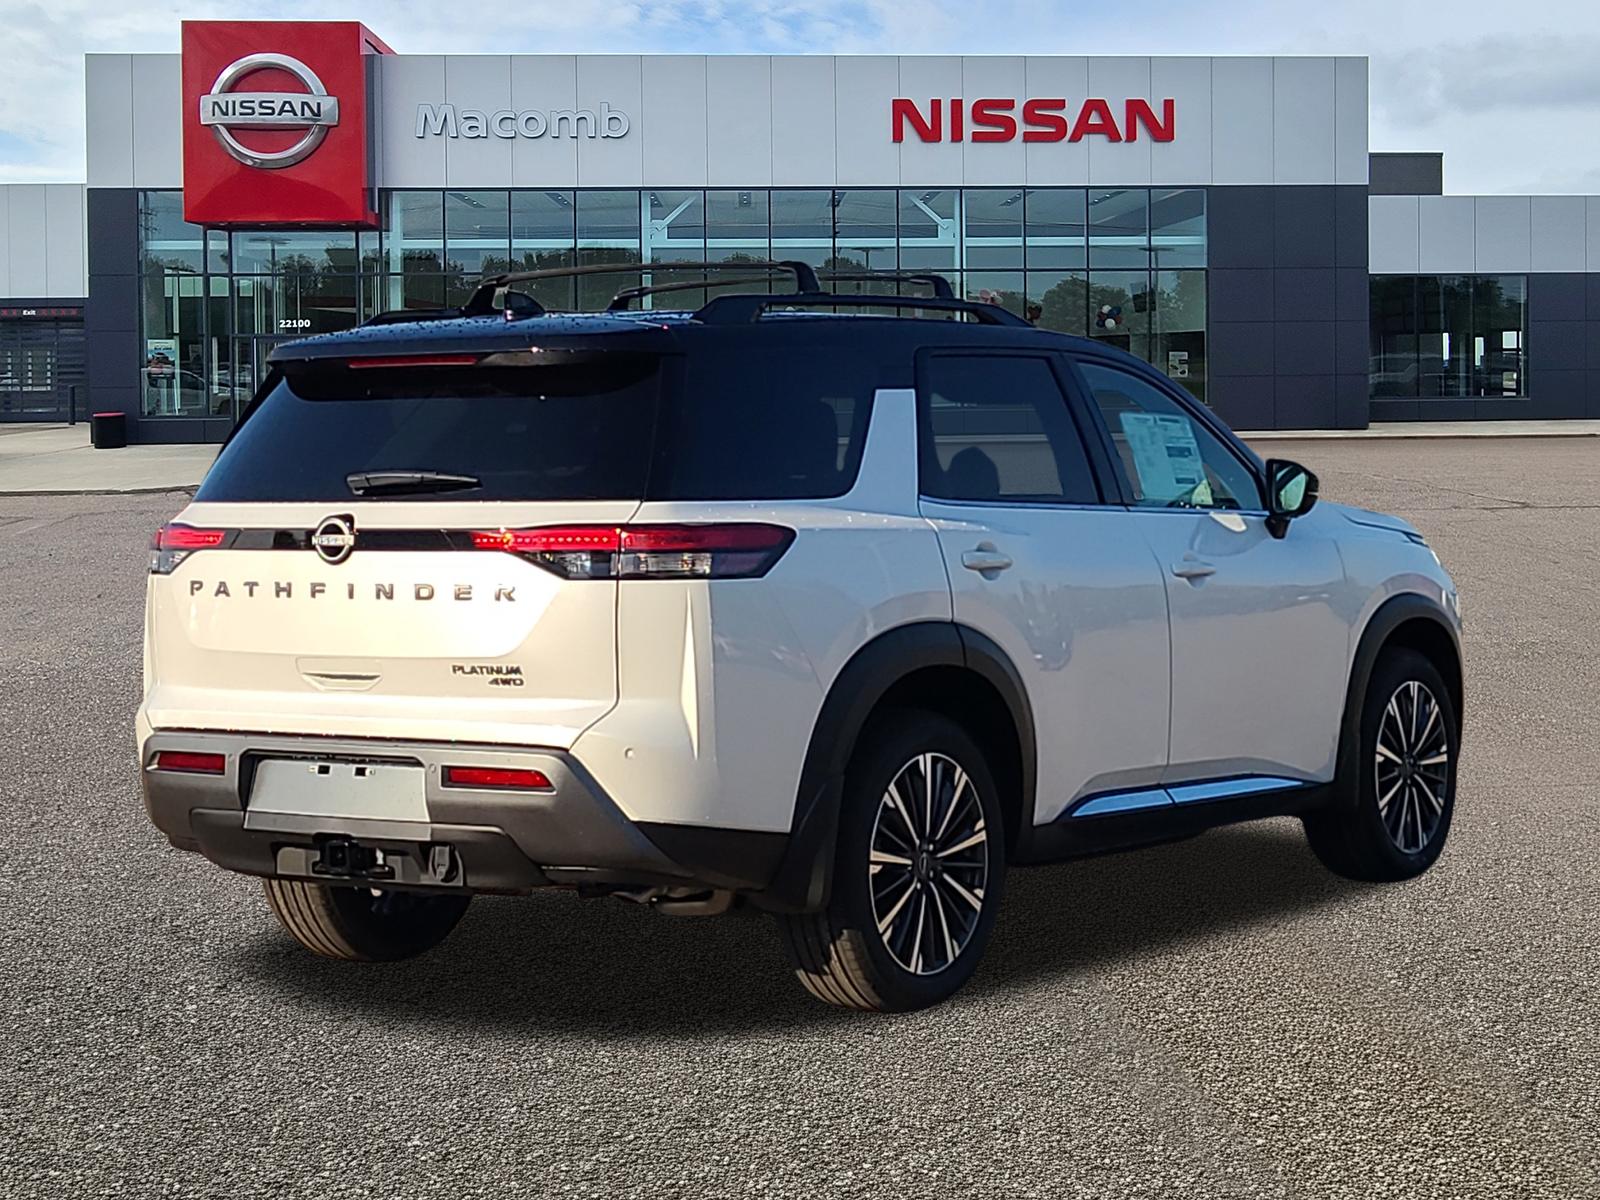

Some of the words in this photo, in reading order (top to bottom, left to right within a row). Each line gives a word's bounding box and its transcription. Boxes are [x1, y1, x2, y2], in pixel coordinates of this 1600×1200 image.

[211, 100, 322, 117] NISSAN
[415, 103, 630, 139] Macomb
[892, 99, 1176, 143] NISSAN
[279, 319, 311, 328] 22100
[190, 580, 519, 602] PATHFINDER
[452, 665, 522, 676] PLATINUM
[488, 678, 524, 687] 4WD
